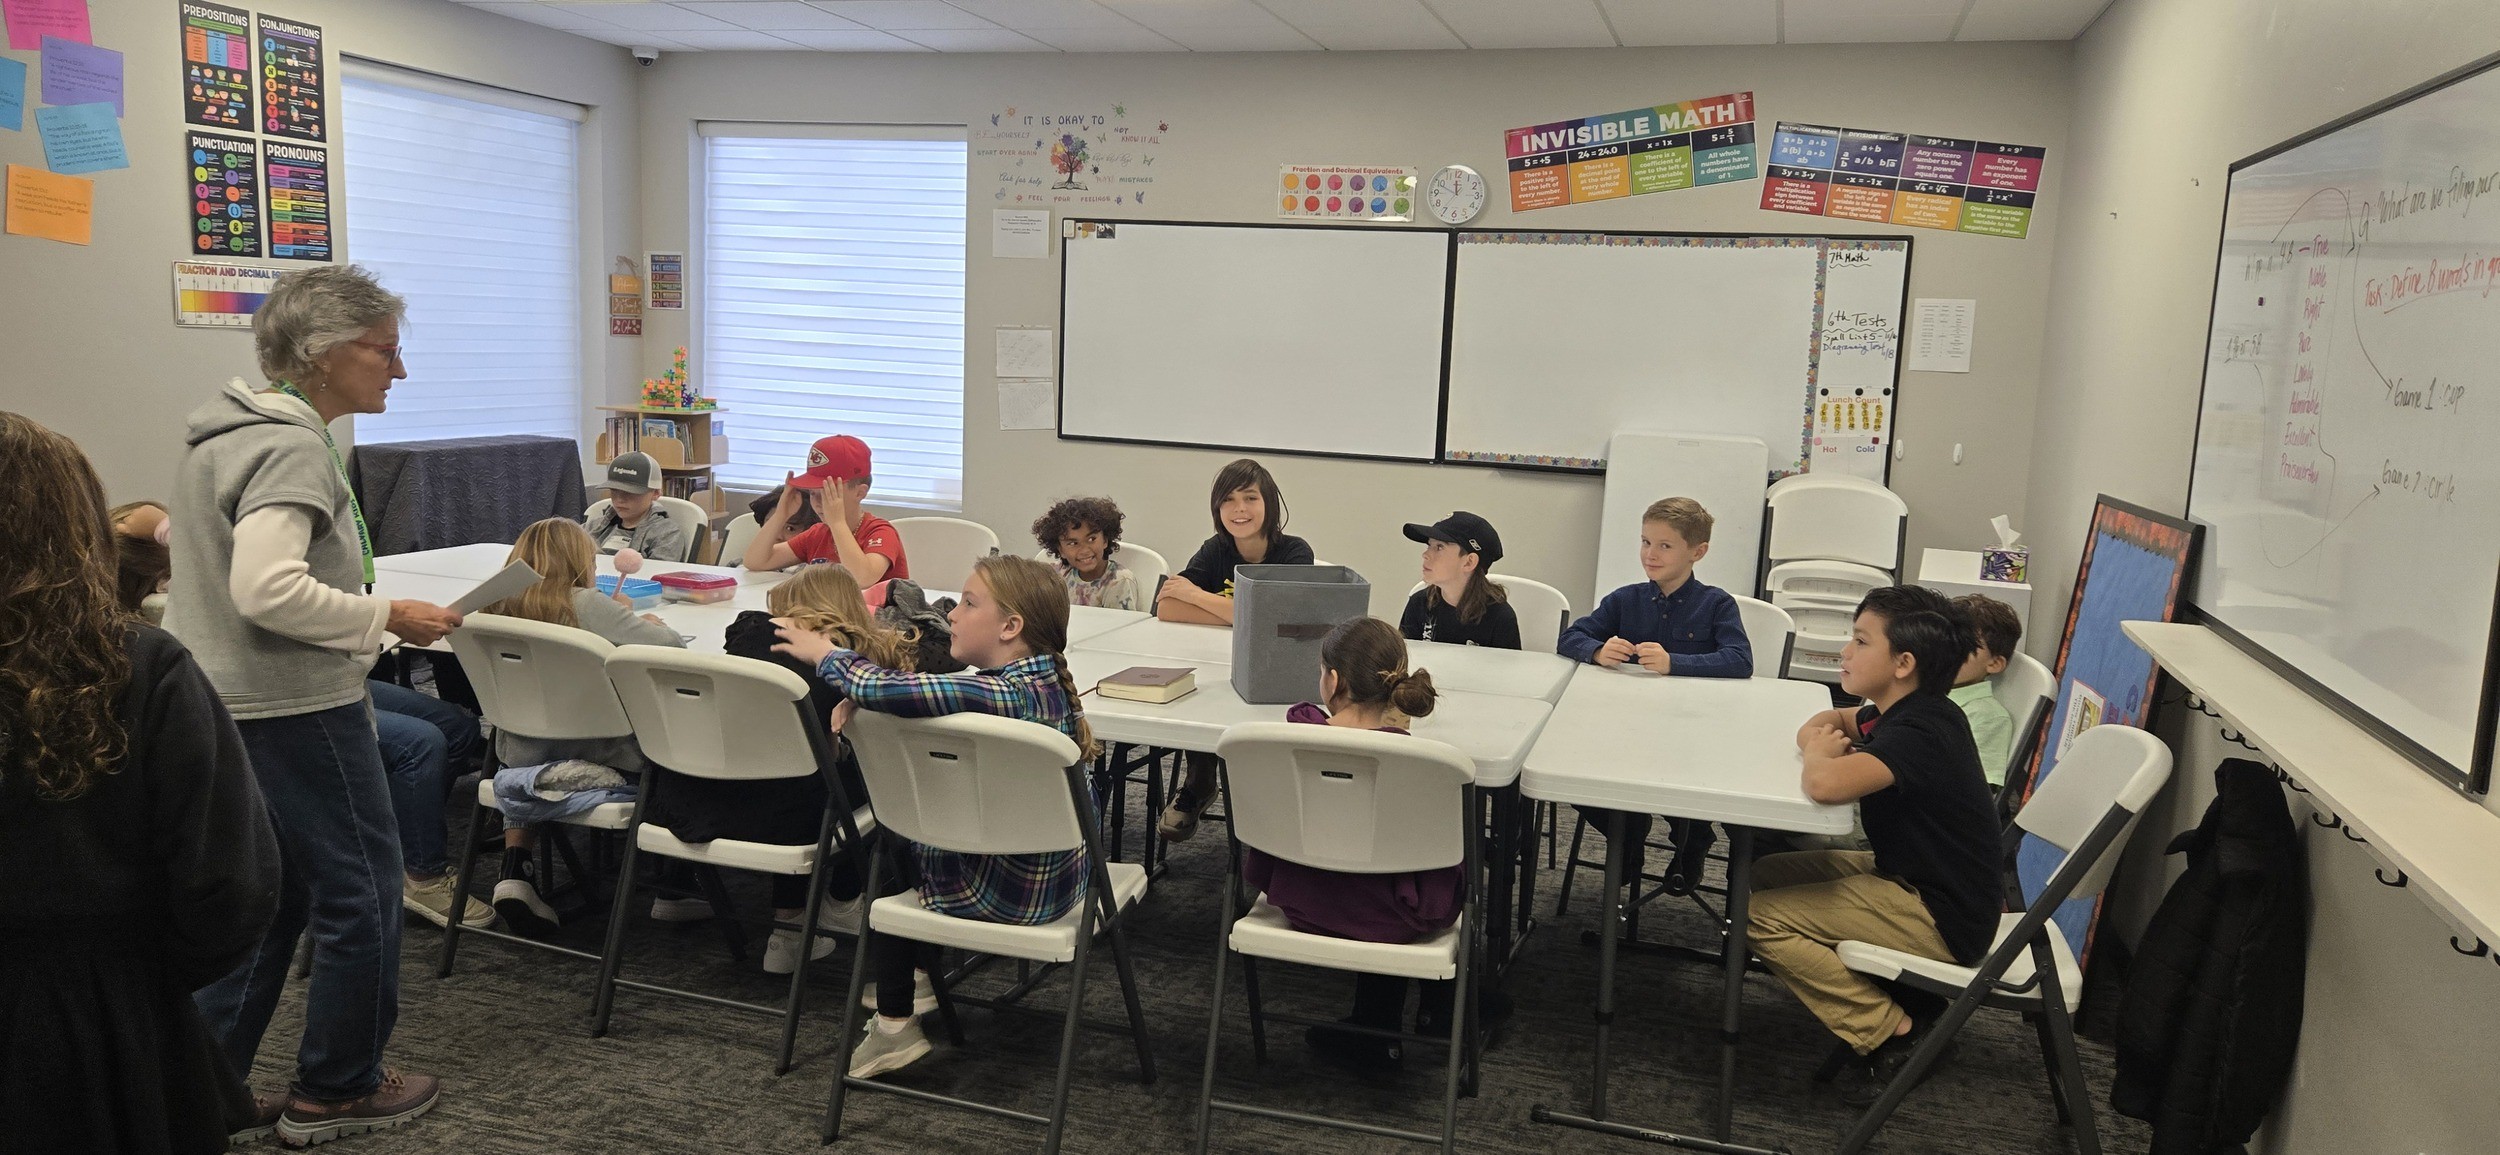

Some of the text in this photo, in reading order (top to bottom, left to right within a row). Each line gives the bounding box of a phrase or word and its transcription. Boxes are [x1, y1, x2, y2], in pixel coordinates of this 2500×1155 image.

[184, 4, 248, 26] PREPOSITIONS
[260, 18, 320, 39] CONJUNCTIONS
[1024, 115, 1104, 125] IT IS OKAY TO
[1522, 102, 1735, 152] INVISIBLE MATH
[1778, 125, 1820, 133] MULTIPLICATION
[1148, 136, 1160, 144] ALL
[1712, 134, 1717, 142] 5
[192, 136, 254, 154] PUNCTUATION
[267, 144, 325, 162] PRONOUNS
[1578, 147, 1618, 159] 24 24.0
[1525, 156, 1551, 167] 5 +5
[1640, 160, 1673, 168] coefficient
[1701, 158, 1731, 167] numbers
[1913, 157, 1940, 165] number
[1998, 158, 2018, 166] Every
[1707, 163, 1750, 174] denominator
[1782, 169, 1792, 177] 3y
[1985, 164, 2014, 172] number
[1455, 170, 1462, 178] 12
[1915, 171, 1938, 179] equals
[1993, 172, 2027, 181] exponent
[1028, 175, 1042, 187] help
[1472, 182, 1477, 190] 2
[1520, 176, 1558, 186] positive sign
[1434, 189, 1439, 197] 9
[1474, 192, 1479, 200] 3
[1537, 188, 1562, 196] number.
[1436, 199, 1441, 207] 8
[2410, 191, 2425, 214] are
[2431, 188, 2443, 210] we
[1452, 210, 1457, 218] 6
[1462, 208, 1466, 216] 5
[2313, 234, 2329, 258] True
[1829, 252, 1869, 263] 7th Math
[178, 265, 217, 275] FRACTION
[219, 267, 236, 276] AND
[238, 269, 270, 278] DECIMAL
[2309, 265, 2326, 289] Noble
[2391, 267, 2425, 300] Define
[2438, 253, 2471, 290] words
[2474, 252, 2484, 280] in
[2303, 294, 2325, 329] Right
[1828, 310, 1887, 326] 6th Tests
[1824, 333, 1844, 345] Spell
[2299, 331, 2311, 355] Pure
[1867, 341, 1885, 349] Test
[2293, 361, 2314, 398] Lovely
[2394, 378, 2421, 408] Game
[2289, 389, 2319, 415] Admirable
[2284, 421, 2316, 447] Excellent
[2282, 453, 2319, 483] Praiseworthy
[2382, 458, 2408, 490] Game
[351, 499, 370, 555] CALVARY KIDS
